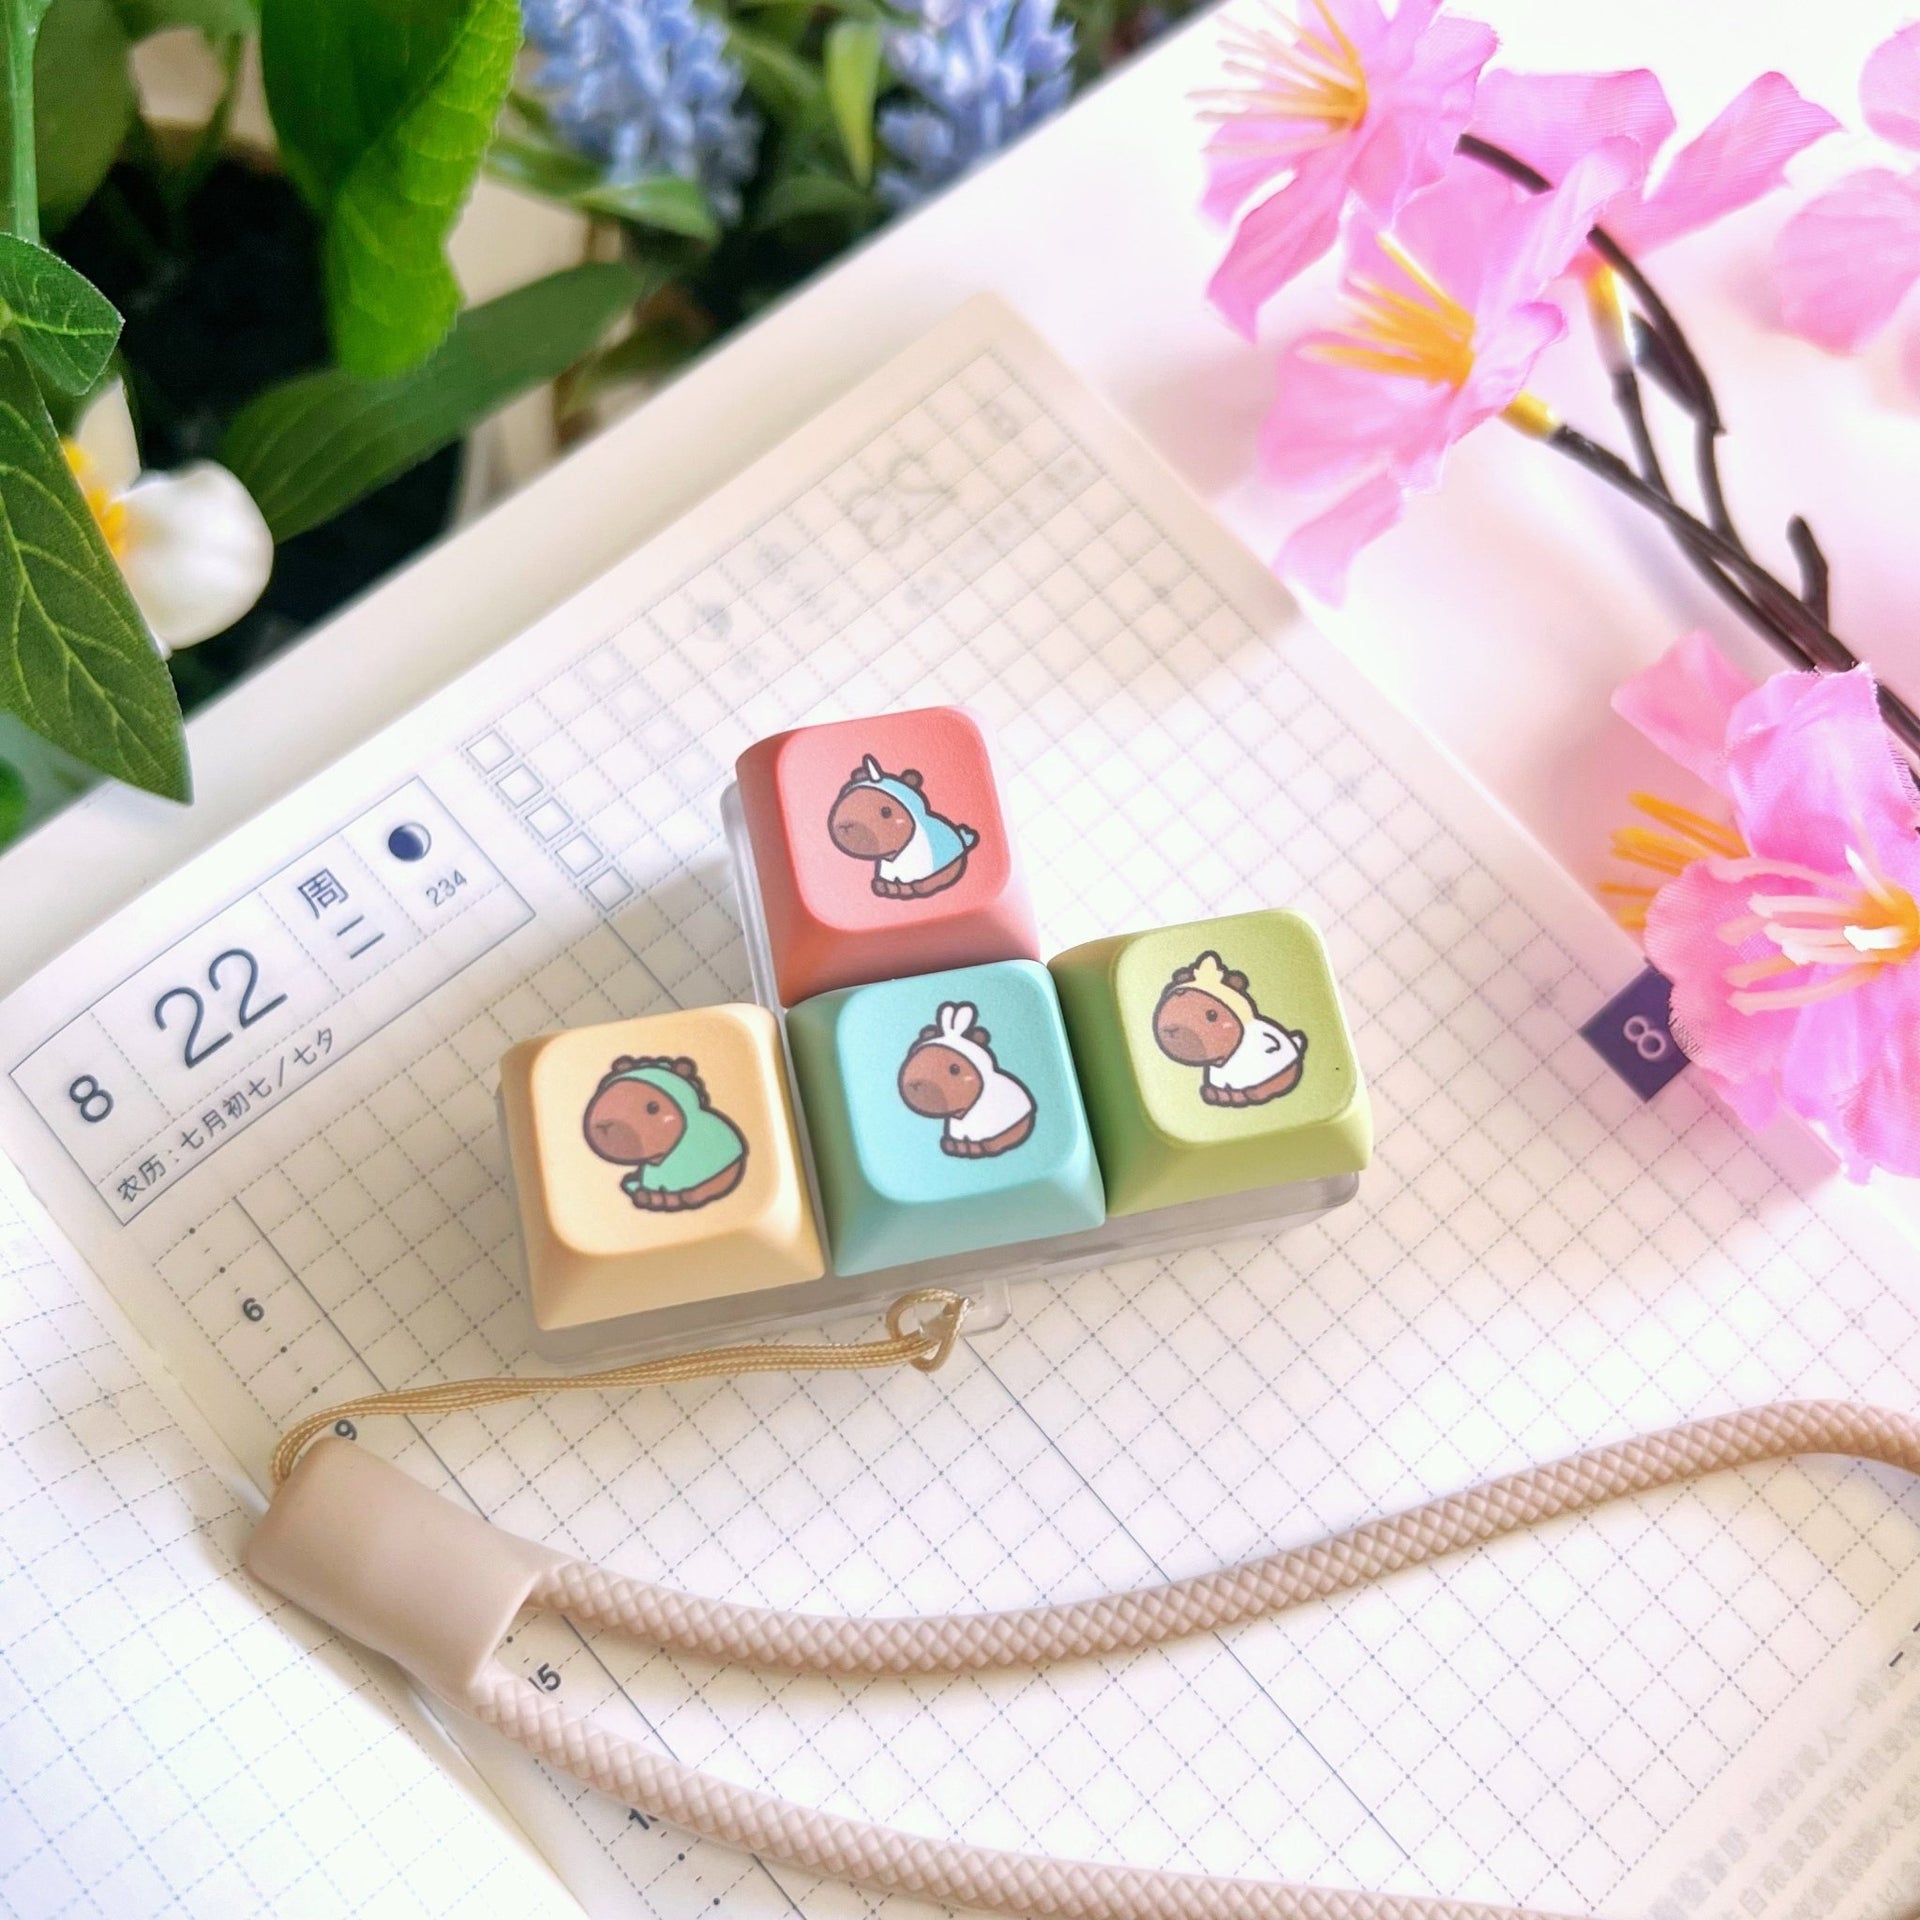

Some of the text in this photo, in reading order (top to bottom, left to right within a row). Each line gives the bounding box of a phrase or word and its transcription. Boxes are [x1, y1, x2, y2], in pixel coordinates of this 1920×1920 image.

[425, 870, 467, 907] 234
[153, 948, 288, 1069] 22
[1623, 1015, 1666, 1060] 8
[68, 1074, 114, 1124] 8
[242, 1298, 265, 1322] 6
[335, 1419, 357, 1441] 9
